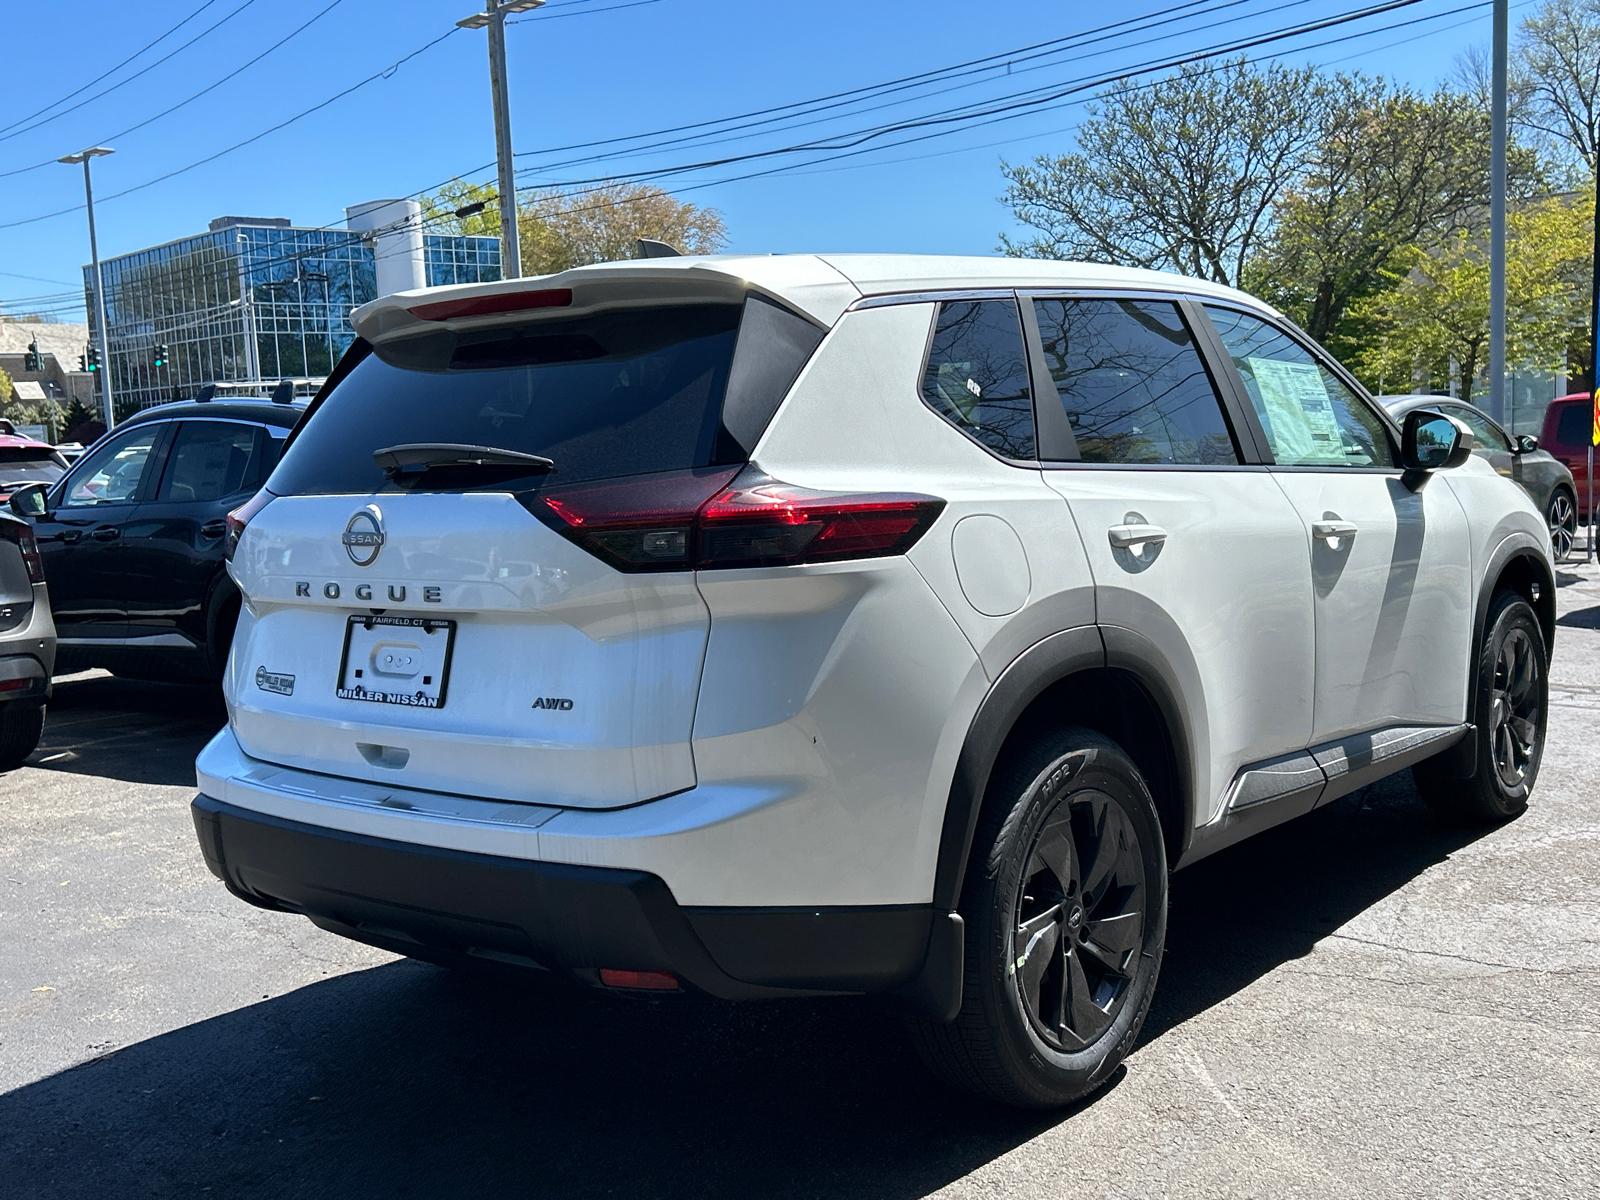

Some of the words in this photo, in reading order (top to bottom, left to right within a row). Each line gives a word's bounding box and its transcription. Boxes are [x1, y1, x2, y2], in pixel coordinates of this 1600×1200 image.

[295, 581, 442, 603] ROGUE
[372, 617, 411, 626] FAIRFIELD,
[338, 689, 383, 702] MILLER
[387, 694, 438, 707] NISSAN
[531, 697, 574, 711] AWD
[1041, 763, 1072, 801] HP2
